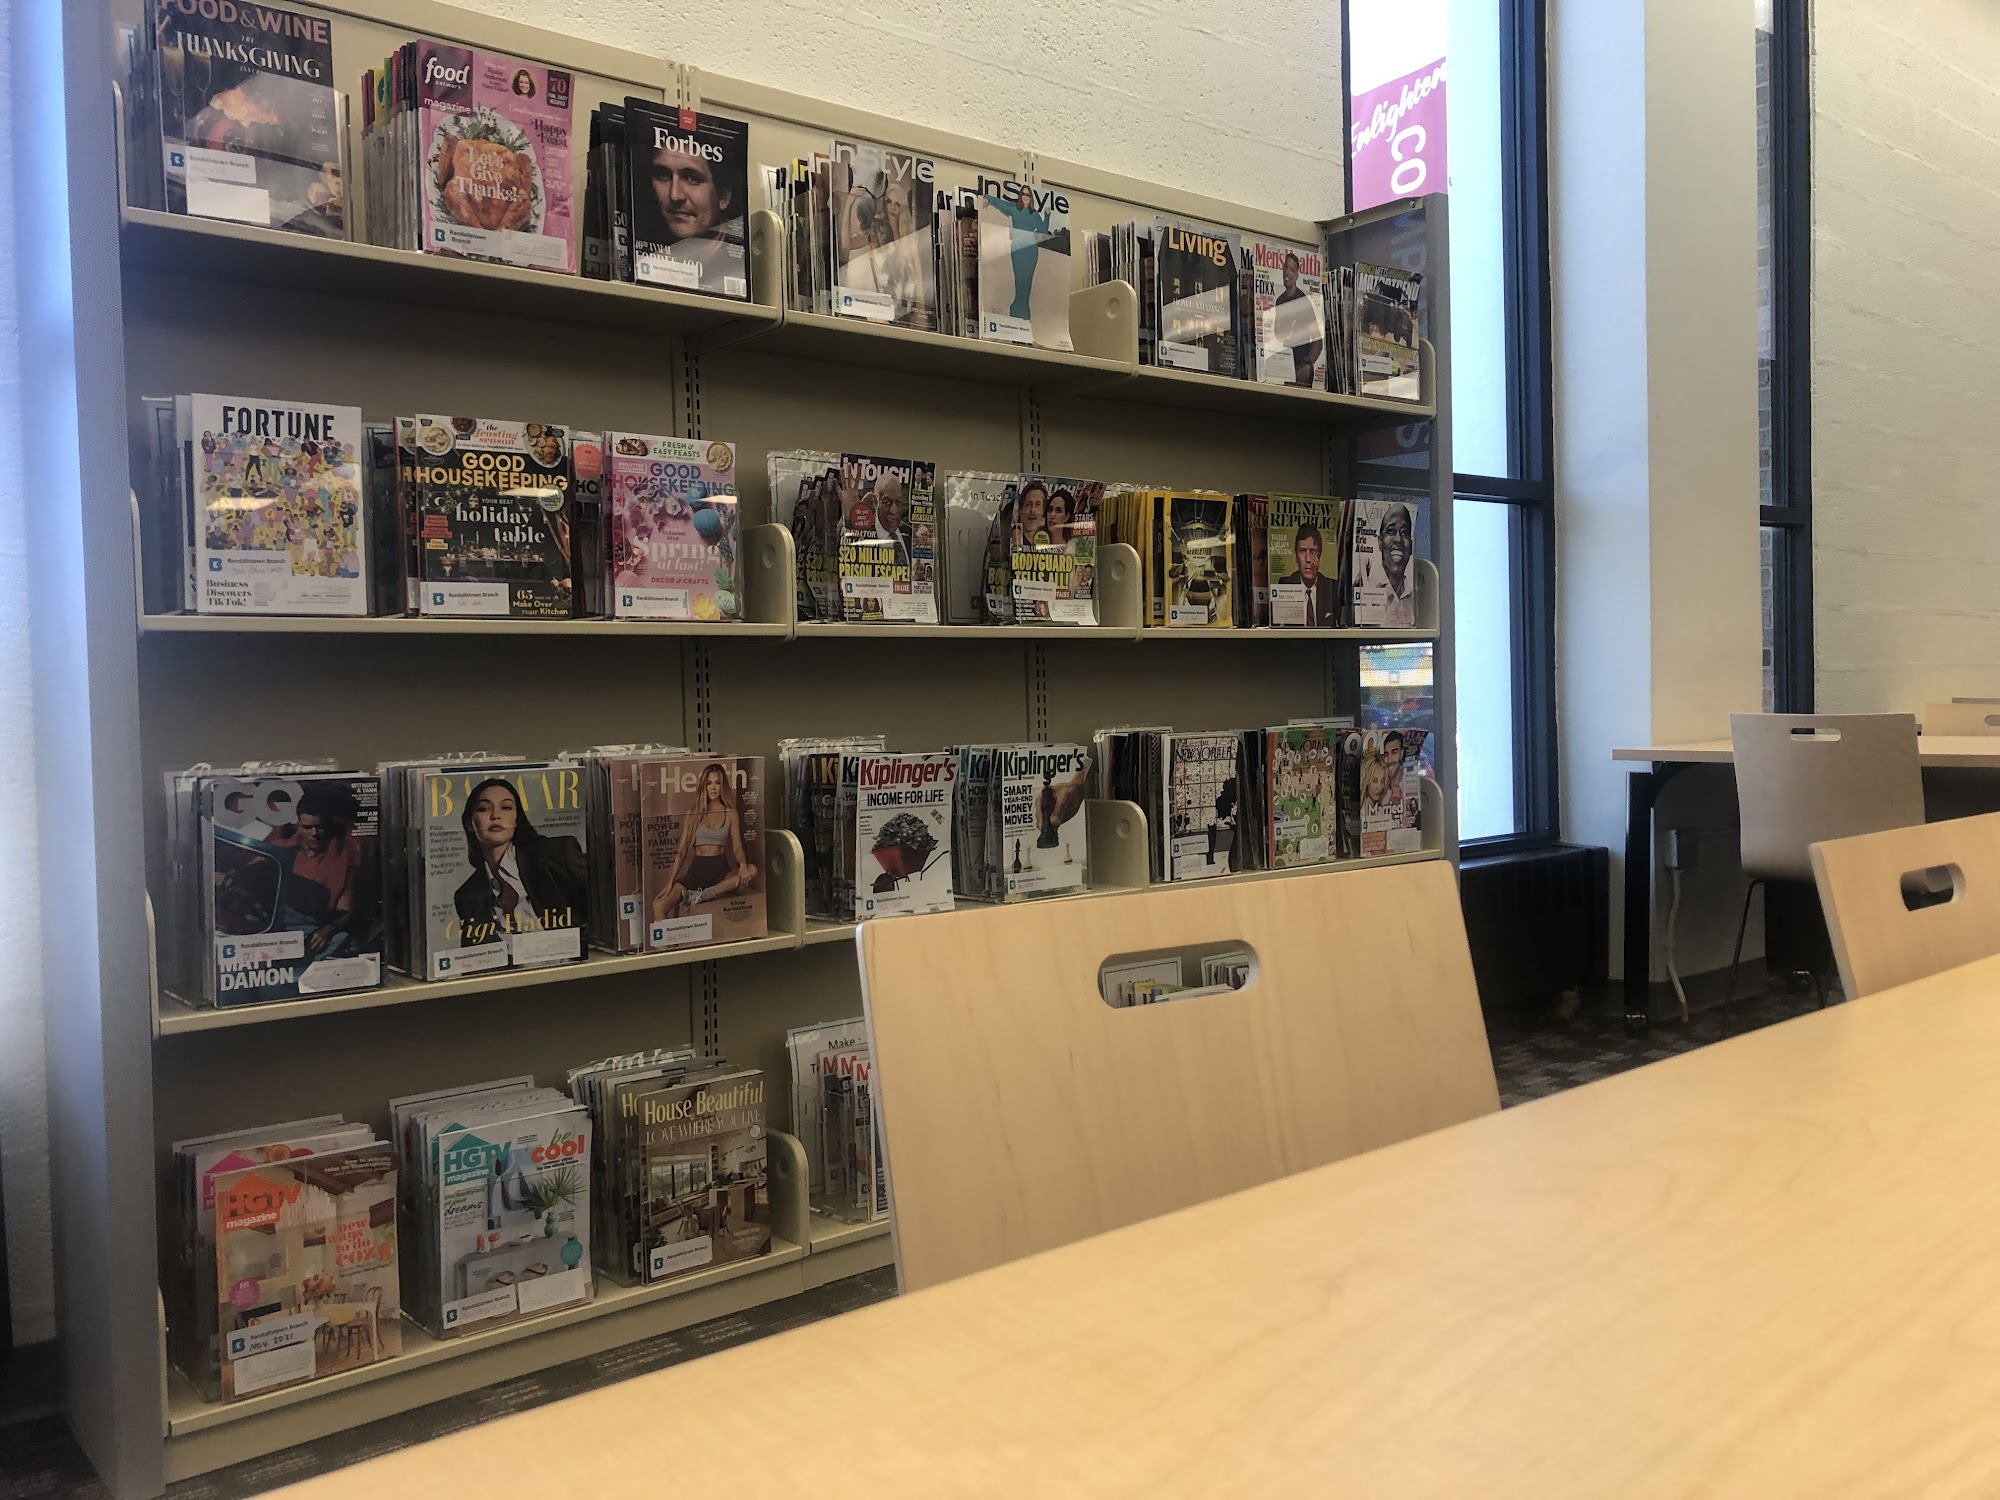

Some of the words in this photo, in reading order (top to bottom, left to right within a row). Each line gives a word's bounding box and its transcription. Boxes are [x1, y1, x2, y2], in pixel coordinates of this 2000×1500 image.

[176, 31, 320, 78] THANKSGIVING
[425, 56, 470, 85] food
[550, 77, 567, 94] 70
[424, 97, 471, 114] magazine
[531, 118, 568, 137] Happy
[653, 126, 724, 163] Forbes
[468, 146, 504, 169] Let's
[470, 163, 503, 184] Give
[456, 176, 518, 202] Thanks!
[978, 175, 1070, 215] InSyle
[1168, 224, 1228, 267] Living
[1255, 243, 1285, 270] Men's
[1255, 279, 1275, 296] FOXX
[222, 405, 335, 442] FORTUNE
[486, 422, 498, 431] the
[475, 428, 519, 440] feasting
[653, 447, 672, 456] EASY
[674, 449, 701, 458] FEASTS
[662, 441, 686, 450] FRESH
[462, 452, 526, 472] GOOD
[650, 462, 701, 480] GOOD
[415, 466, 568, 491] HOUSEKEEPING
[456, 502, 533, 527] holiday
[1074, 513, 1094, 522] STARS
[1274, 500, 1300, 514] THE
[1302, 501, 1334, 517] NEW
[1270, 513, 1337, 530] REPUBLIC
[1357, 518, 1367, 526] The
[494, 525, 545, 544] table
[1355, 536, 1367, 544] Eric
[839, 546, 857, 563] $20
[858, 547, 895, 564] MILLION
[1012, 552, 1073, 573] BODYGUARD
[839, 562, 873, 579] PRISON
[875, 565, 911, 582] ESCAPE!
[206, 579, 249, 588] Business
[206, 588, 252, 597] Discovers
[516, 590, 533, 600] 65
[1196, 746, 1231, 761] YORKER
[860, 757, 957, 789] Kiplinger's
[1003, 749, 1085, 780] Kiplinger's
[660, 763, 747, 795] Heh
[431, 770, 579, 817] BAAR
[867, 792, 903, 807] INCOME
[905, 791, 923, 804] FOR
[925, 789, 944, 802] LIFE
[1004, 785, 1033, 796] SMART
[1004, 803, 1033, 814] MONEY
[1368, 801, 1404, 816] Married
[647, 822, 680, 832] POWER
[656, 815, 673, 823] THE
[1004, 814, 1033, 826] MOVES
[648, 837, 680, 847] FAMILY
[658, 830, 670, 838] OF
[445, 915, 498, 943] Gigi
[505, 906, 572, 934] Hadid
[220, 967, 294, 991] DAMON
[828, 1037, 856, 1050] Make
[645, 1099, 693, 1126] House
[696, 1081, 764, 1116] Beautiful
[679, 1117, 714, 1138] WHERE
[550, 1128, 571, 1146] be
[444, 1141, 512, 1173] HGTV
[531, 1135, 585, 1163] cool
[447, 1168, 490, 1182] magazine
[444, 1201, 483, 1217] dreams
[226, 1211, 278, 1229] magazine
[337, 1219, 367, 1232] new
[336, 1242, 349, 1253] to
[353, 1239, 370, 1250] do
[289, 1321, 309, 1329] Branch
